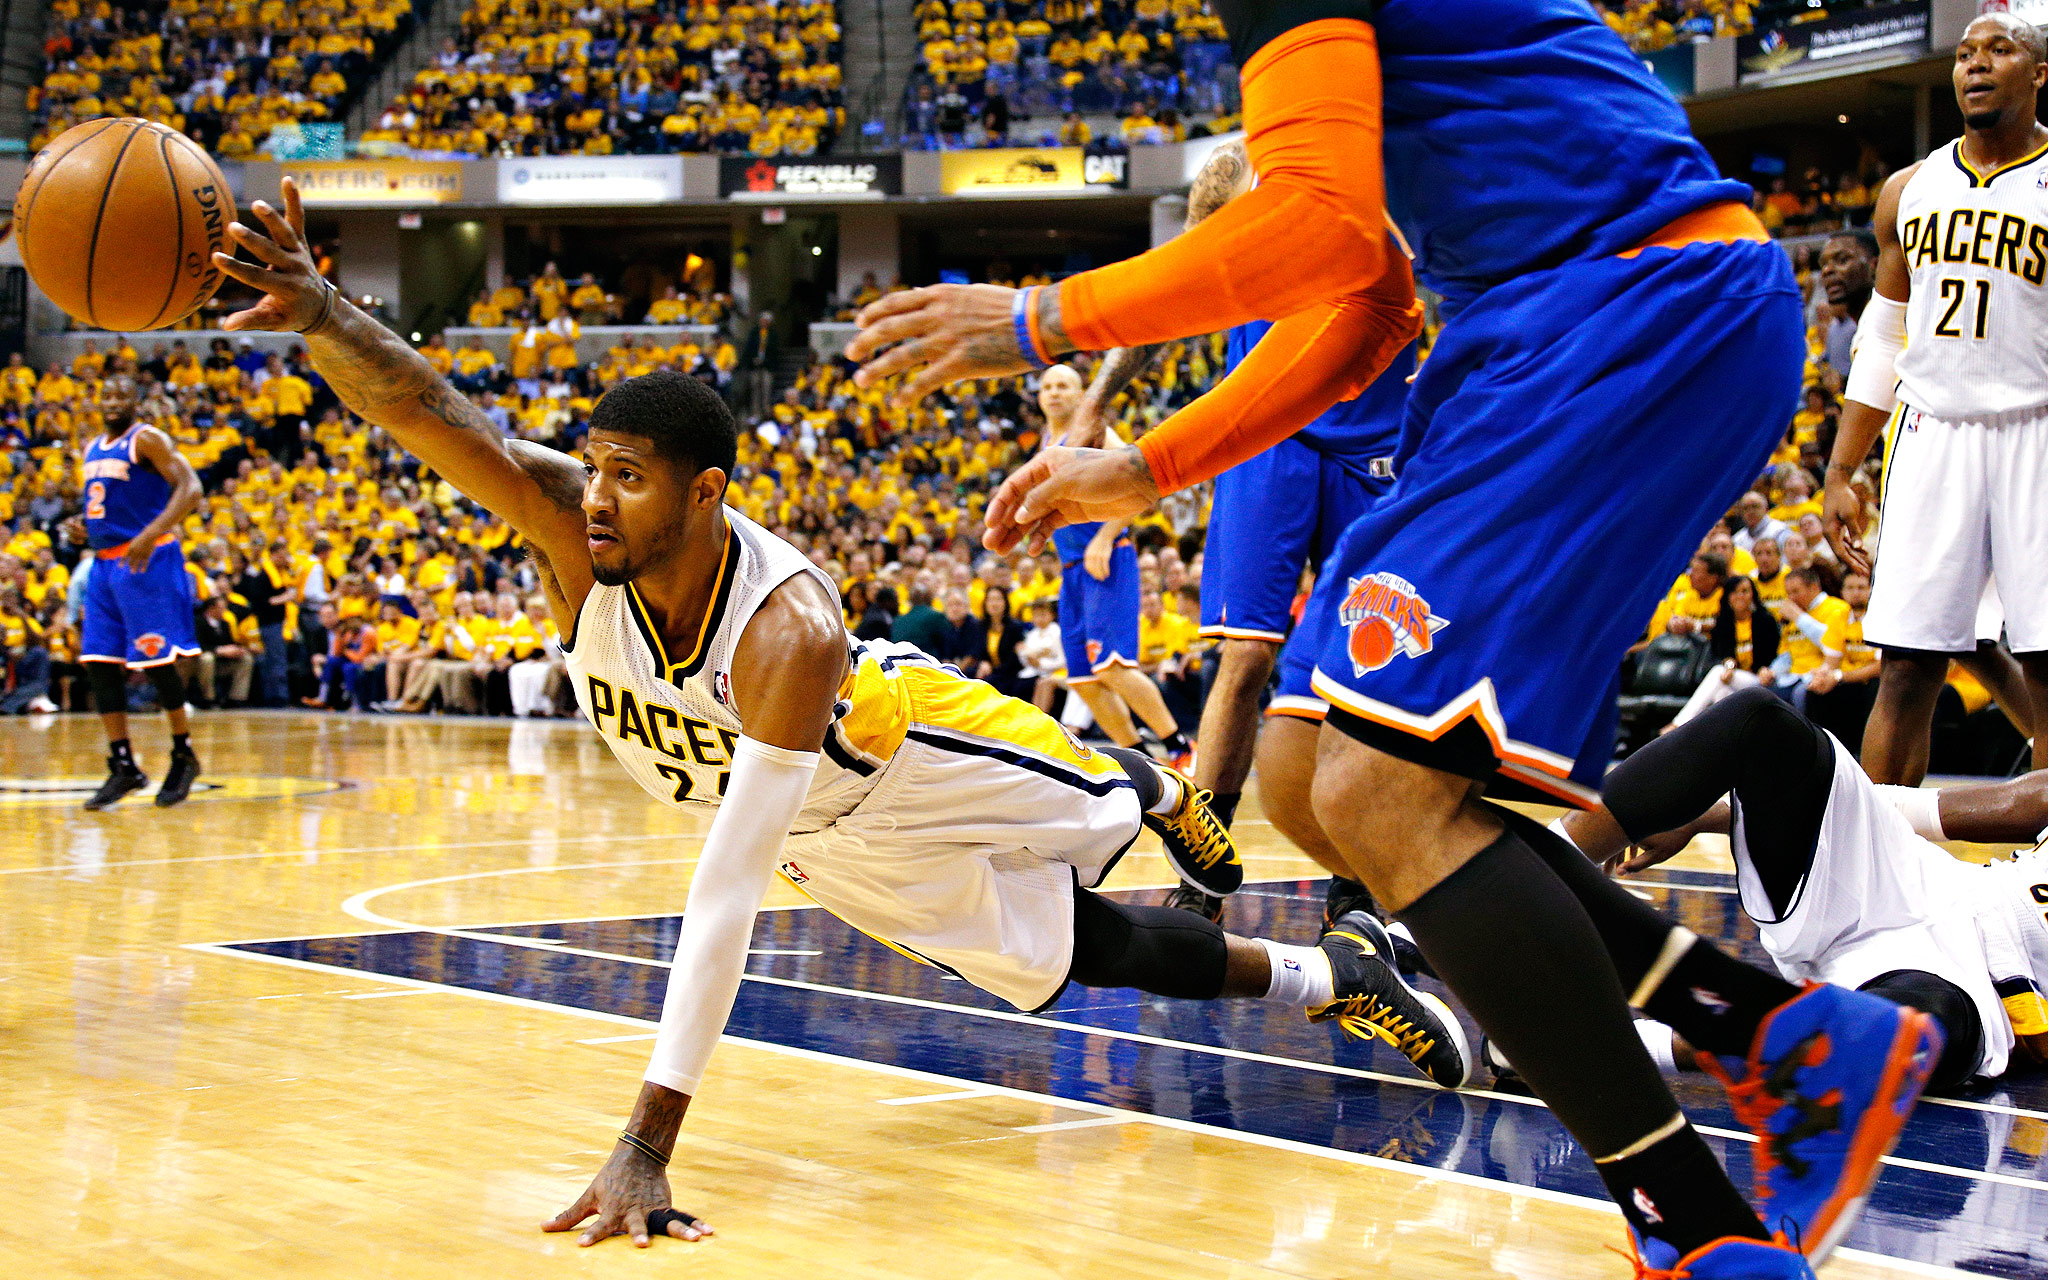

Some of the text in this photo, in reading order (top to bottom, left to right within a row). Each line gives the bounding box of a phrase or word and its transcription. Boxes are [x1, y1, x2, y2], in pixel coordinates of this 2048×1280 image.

[776, 164, 878, 183] REPUBLIC
[1084, 154, 1126, 183] CAT
[1903, 209, 2048, 287] PACERS
[1935, 278, 1990, 339] 21
[86, 481, 106, 519] 2
[1340, 577, 1430, 651] KNICKS
[587, 673, 742, 766] PACE
